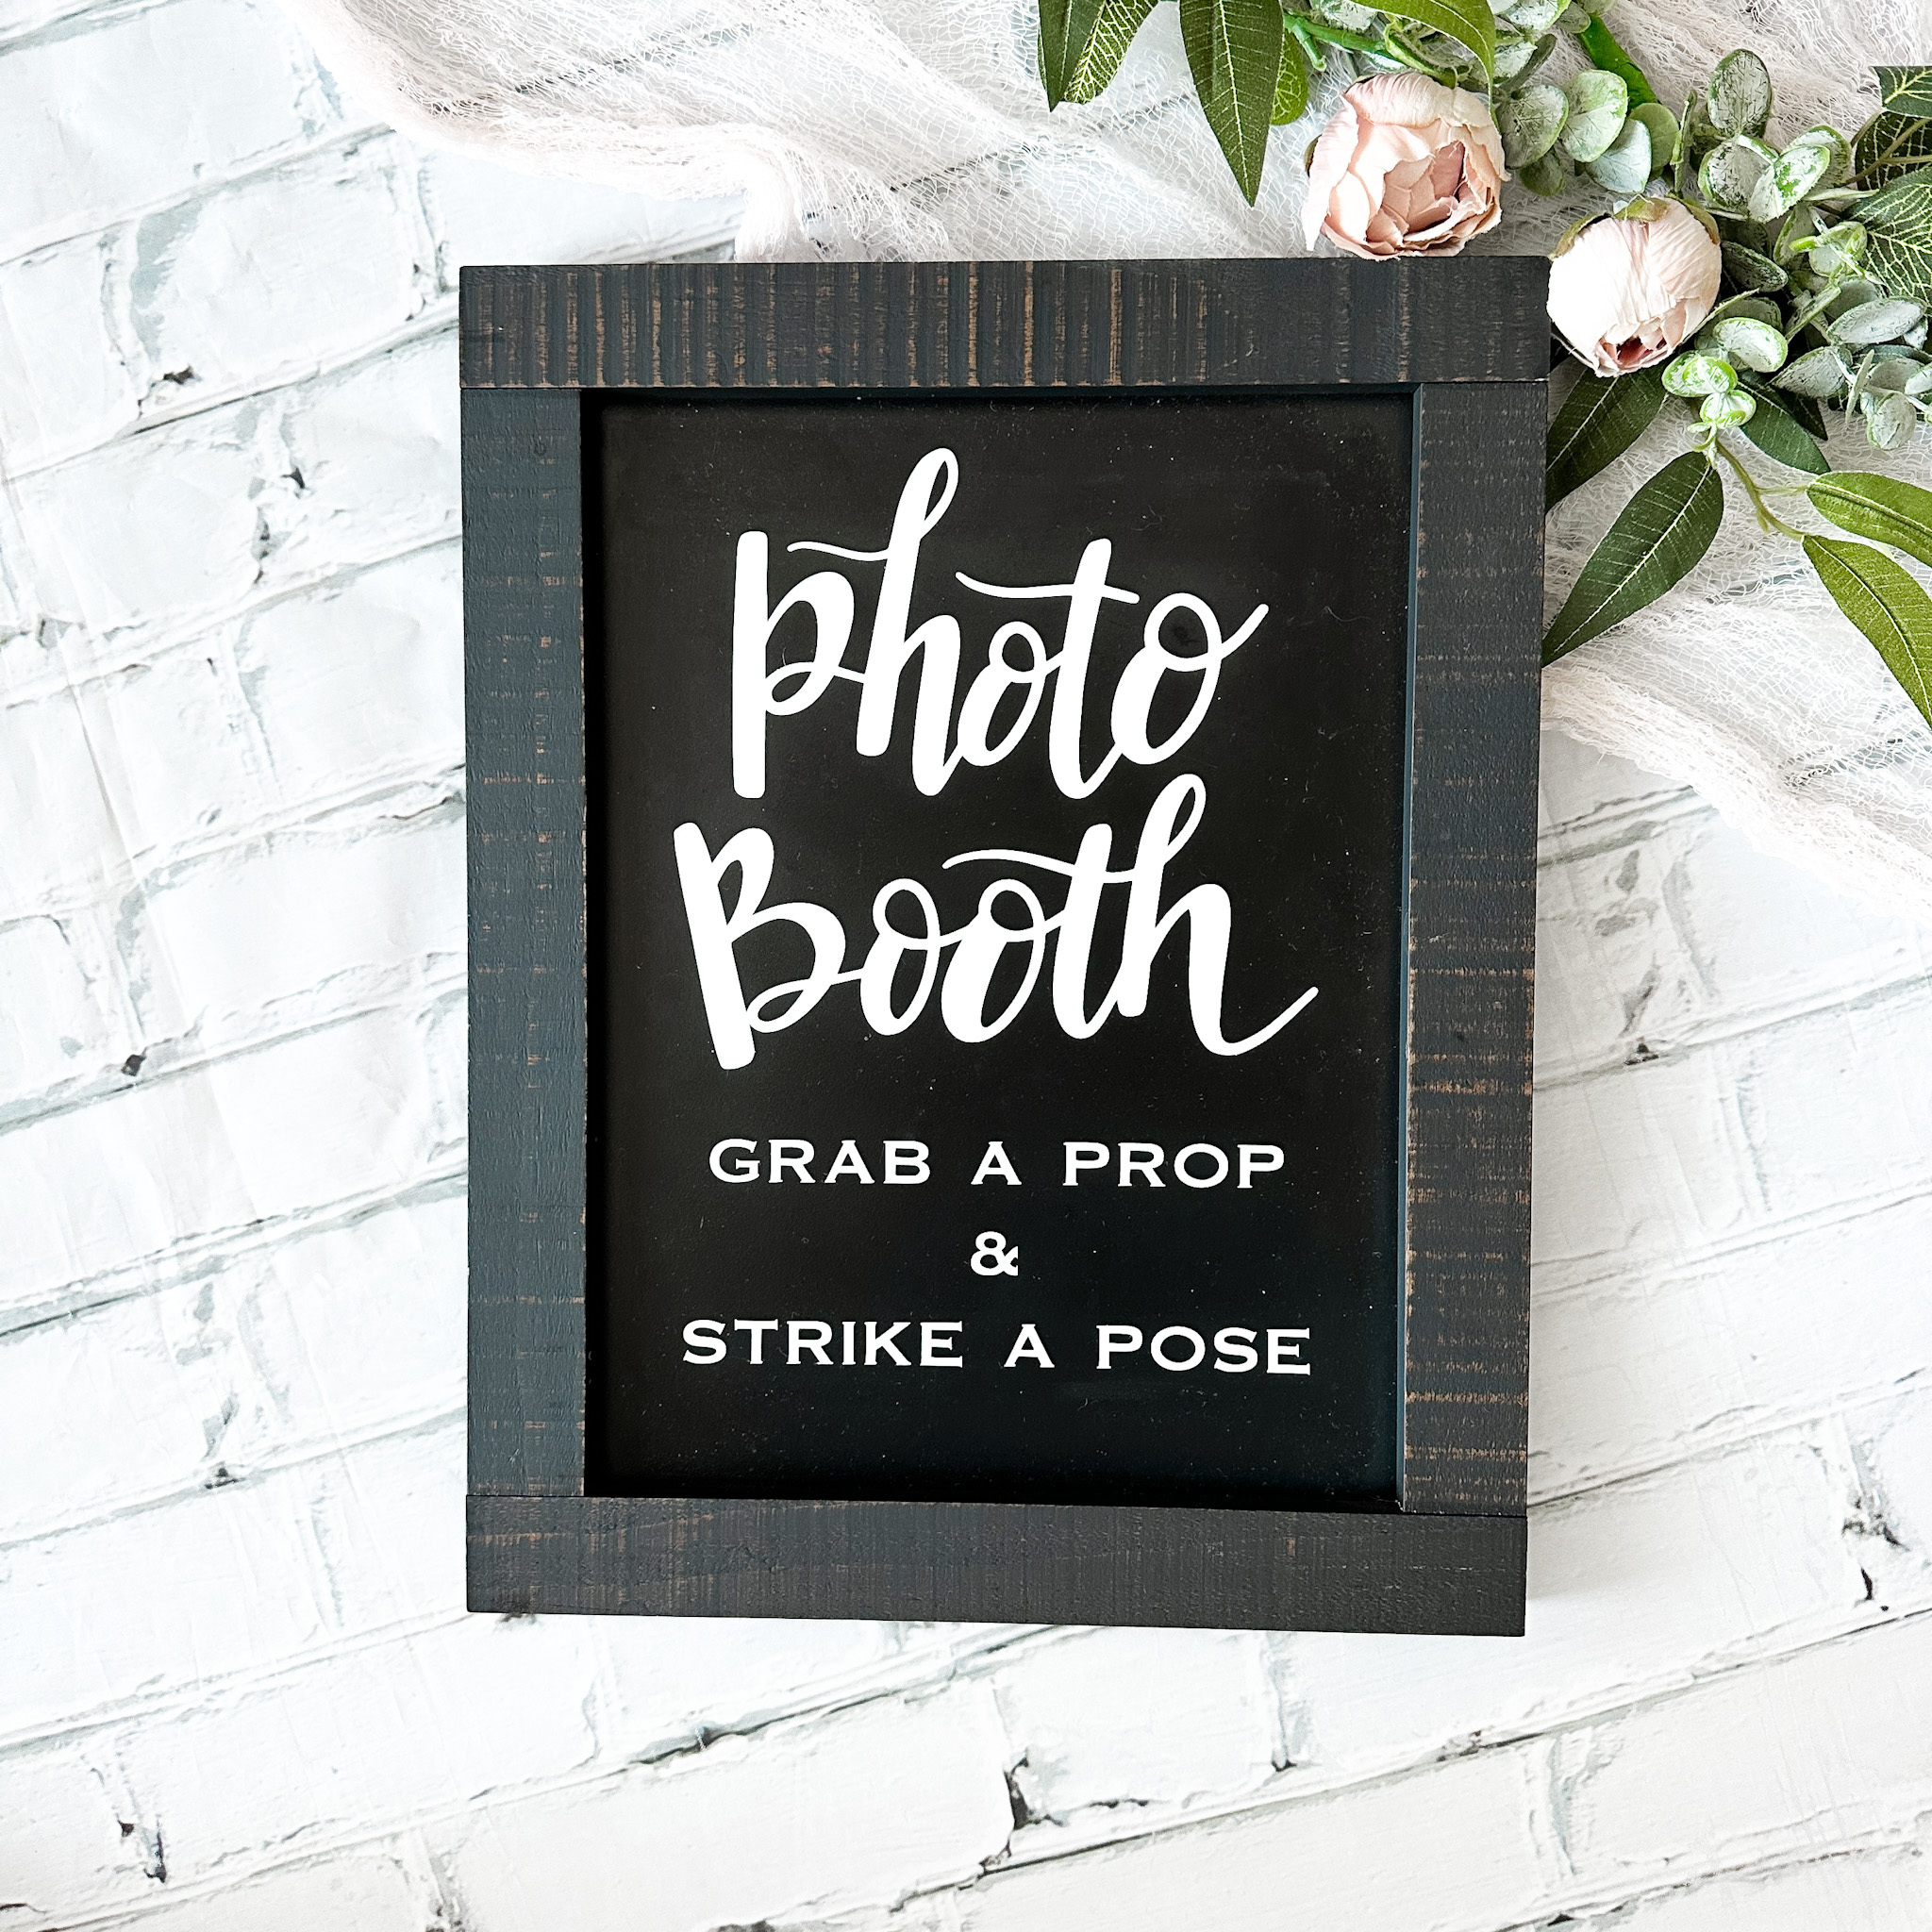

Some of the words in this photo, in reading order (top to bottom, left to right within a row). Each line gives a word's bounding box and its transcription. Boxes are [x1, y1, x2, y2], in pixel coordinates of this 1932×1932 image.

[674, 774, 1318, 1070] Booth
[709, 1139, 930, 1184] GRAB
[971, 1141, 1022, 1185] A
[1063, 1142, 1285, 1189] PROP
[970, 1231, 1019, 1276] &
[682, 1319, 963, 1368] STRIKE
[1004, 1324, 1055, 1369] A
[1096, 1324, 1311, 1375] POSE
